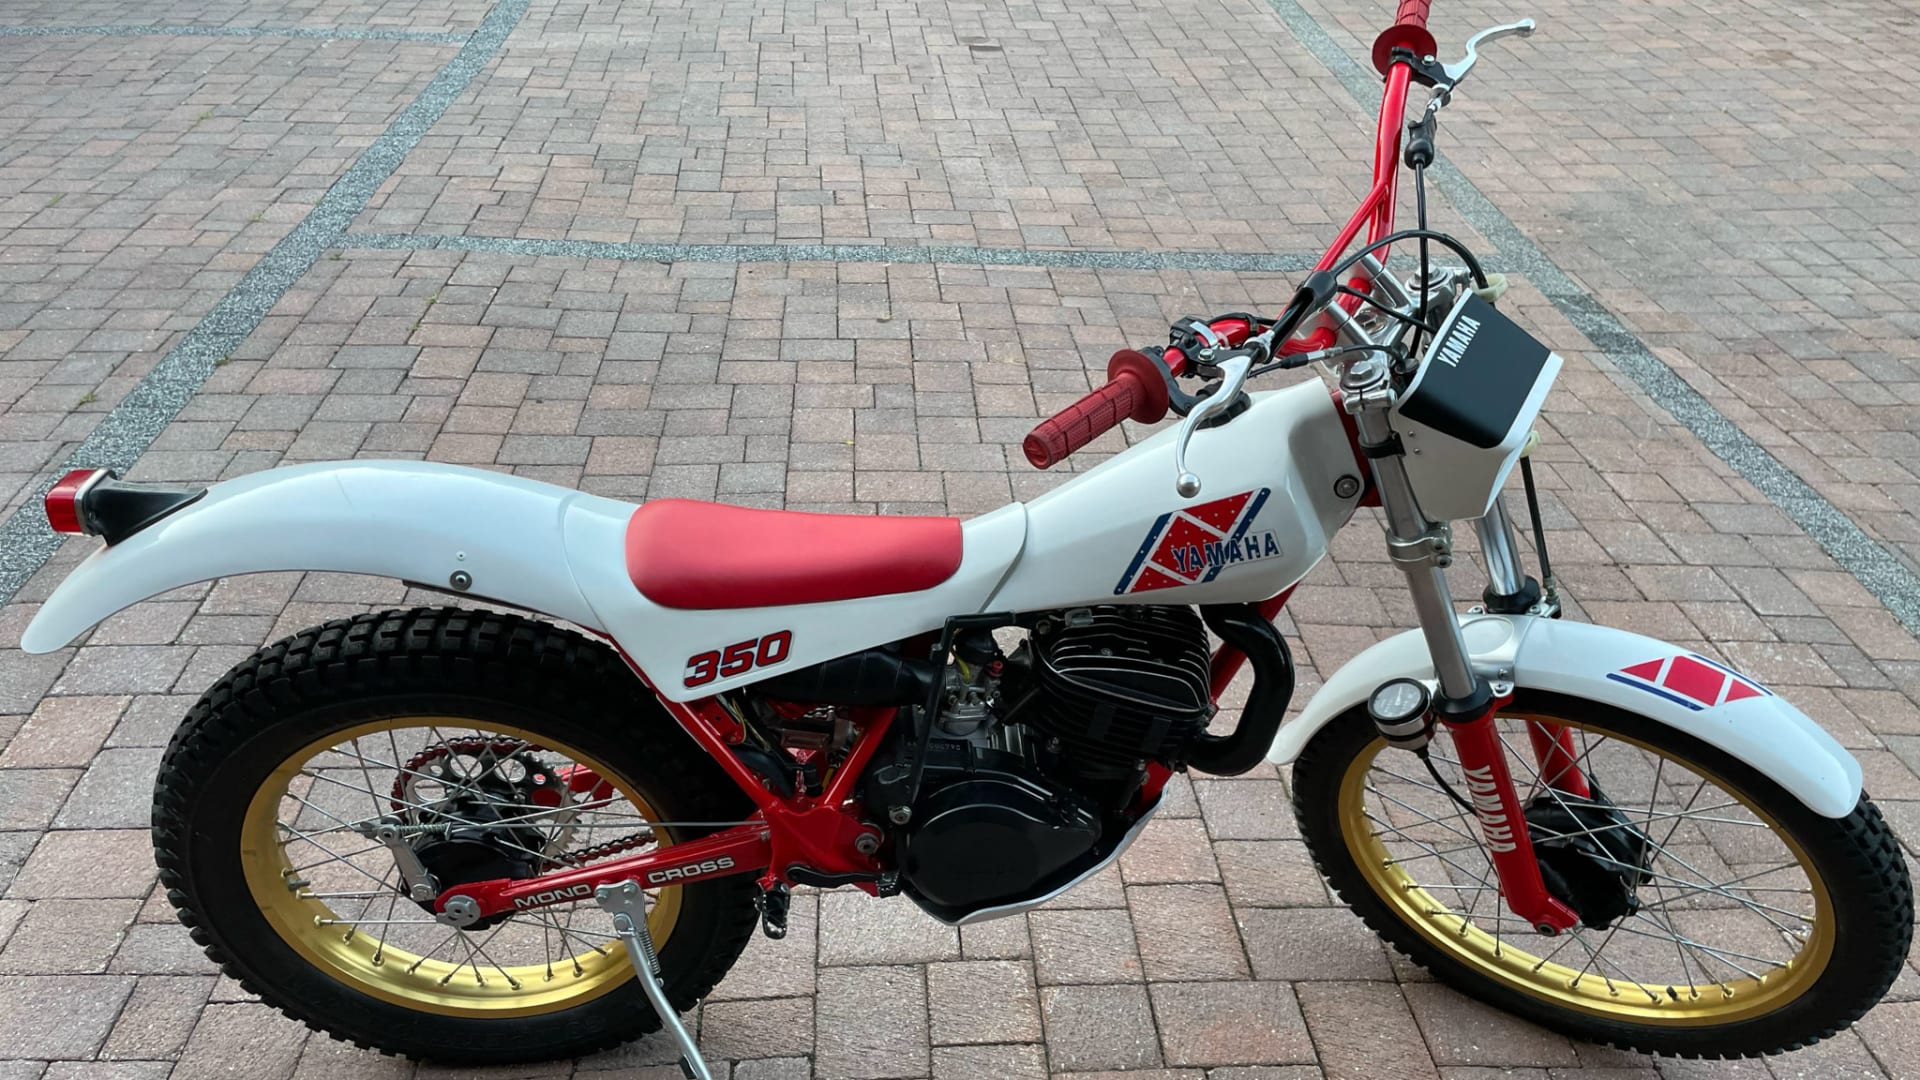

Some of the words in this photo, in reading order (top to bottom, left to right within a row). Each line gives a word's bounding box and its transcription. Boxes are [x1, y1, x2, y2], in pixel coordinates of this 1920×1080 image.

[1437, 315, 1481, 367] YAMAHA
[1172, 532, 1280, 572] YAMAHA
[684, 629, 793, 688] 350
[1464, 764, 1517, 853] YAMAHA
[514, 883, 592, 909] MONO
[647, 856, 736, 884] CROSS
